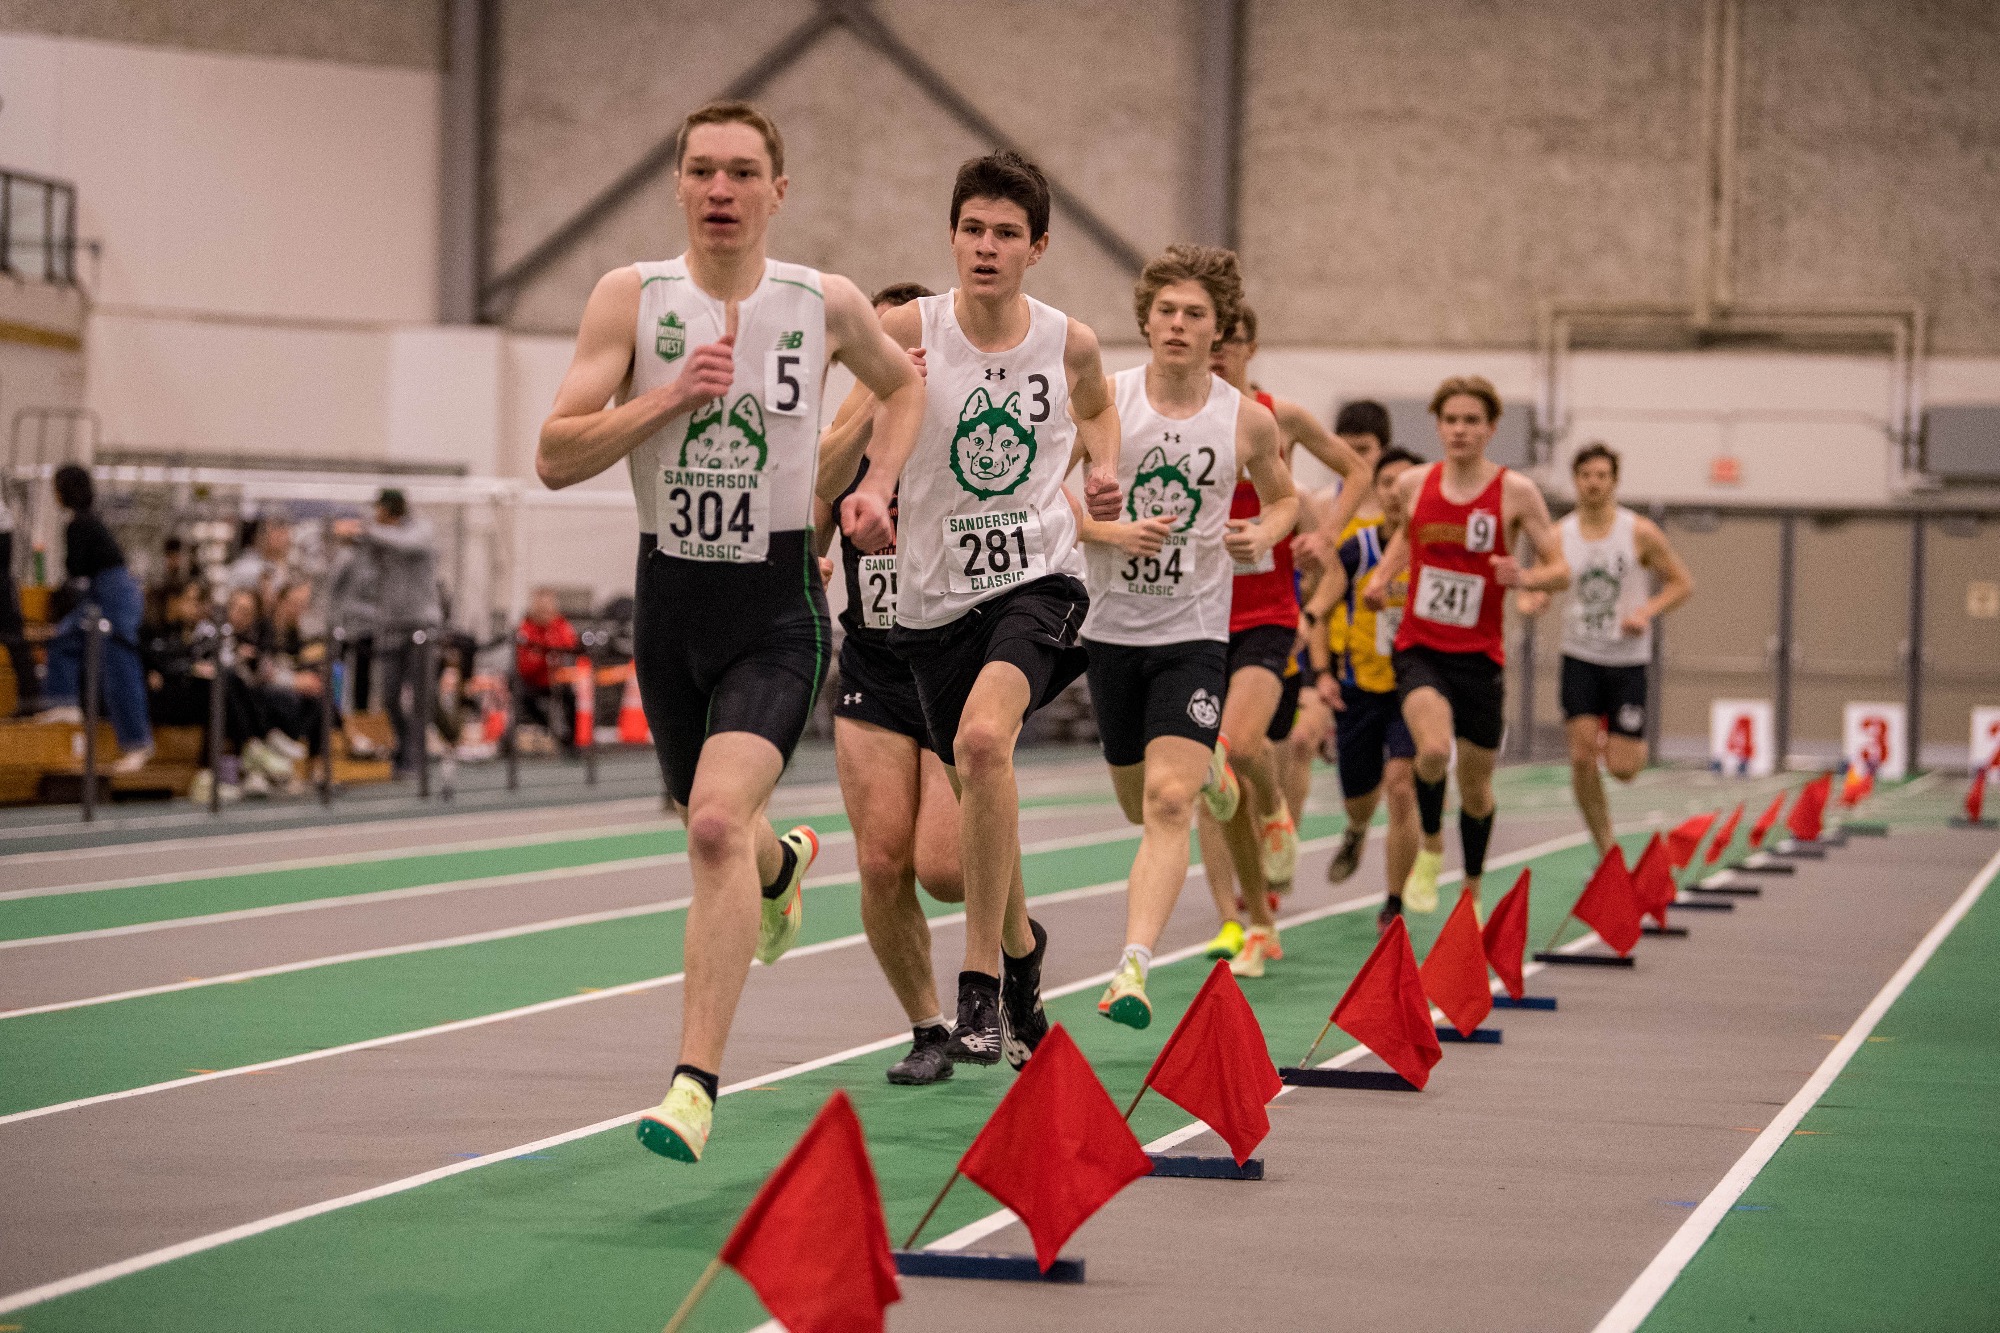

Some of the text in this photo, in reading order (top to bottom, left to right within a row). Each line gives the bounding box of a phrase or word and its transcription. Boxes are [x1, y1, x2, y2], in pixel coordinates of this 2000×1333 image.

[659, 339, 682, 354] WEST
[776, 355, 800, 411] 5
[1028, 373, 1050, 422] 3
[664, 470, 758, 489] SANDERSON
[1196, 447, 1216, 486] 2
[669, 488, 754, 543] 304
[949, 511, 1028, 532] SANDERSON
[680, 540, 742, 560] CLASSIC
[1160, 535, 1188, 546] SON
[1474, 517, 1489, 550] 9
[865, 558, 897, 571] SAND
[959, 526, 1029, 577] 281
[1128, 582, 1174, 596] CLASSIC
[1429, 581, 1469, 614] 241
[1727, 715, 1755, 761] 4
[1861, 716, 1889, 763] 3
